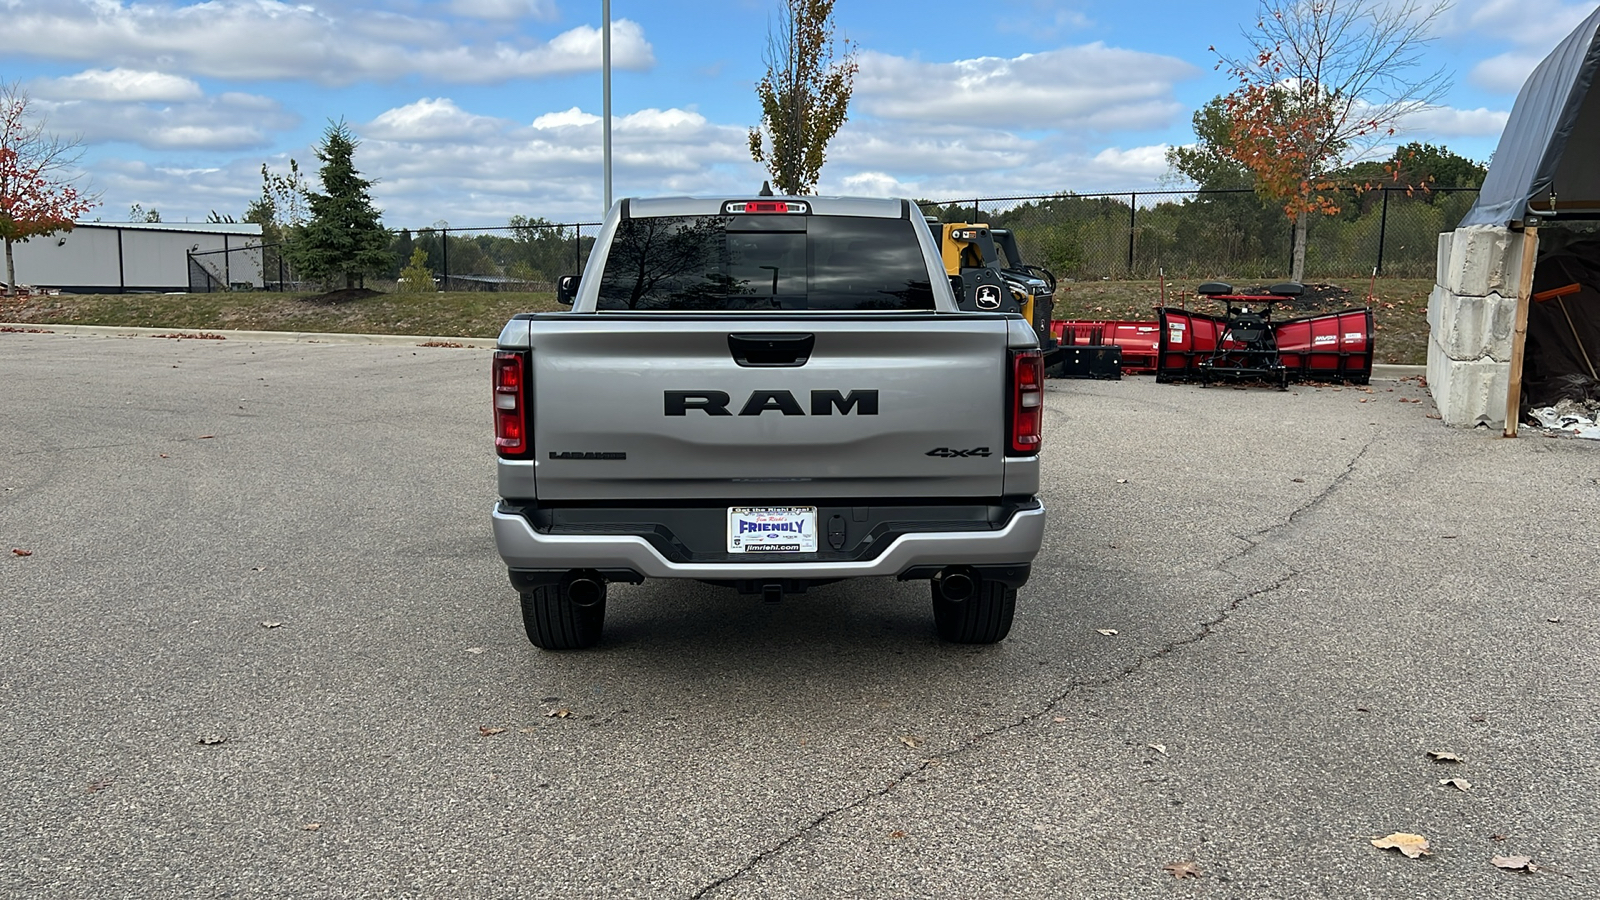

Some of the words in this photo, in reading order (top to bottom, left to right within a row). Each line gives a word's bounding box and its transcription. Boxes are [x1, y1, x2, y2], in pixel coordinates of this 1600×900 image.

[664, 389, 879, 416] RAM
[924, 447, 993, 458] 4x4
[739, 519, 805, 534] FRIENDLY
[746, 544, 799, 552] jimriehl.com
